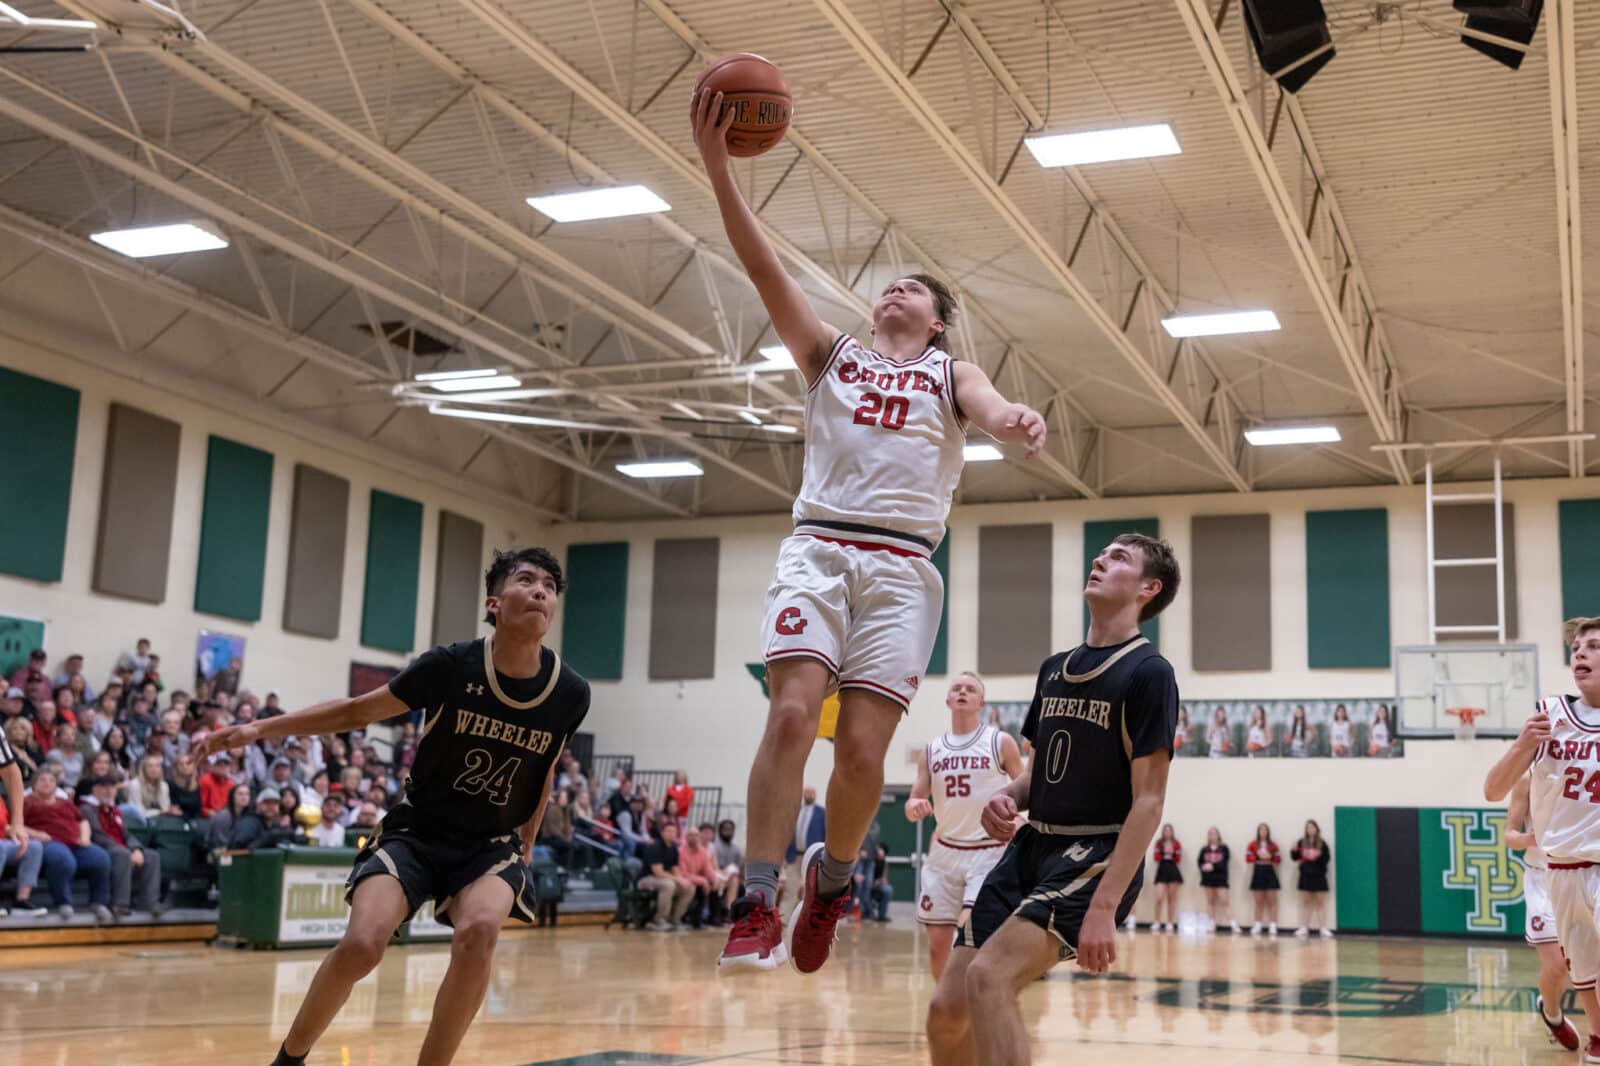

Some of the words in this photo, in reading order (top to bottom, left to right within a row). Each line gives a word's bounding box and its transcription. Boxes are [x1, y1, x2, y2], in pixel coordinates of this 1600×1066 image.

[853, 392, 910, 431] 20
[454, 708, 553, 755] WHEELER
[932, 755, 990, 774] GRUVER
[1046, 729, 1071, 784] 0
[453, 748, 521, 806] 24
[944, 774, 971, 798] 25
[1563, 766, 1600, 804] 24
